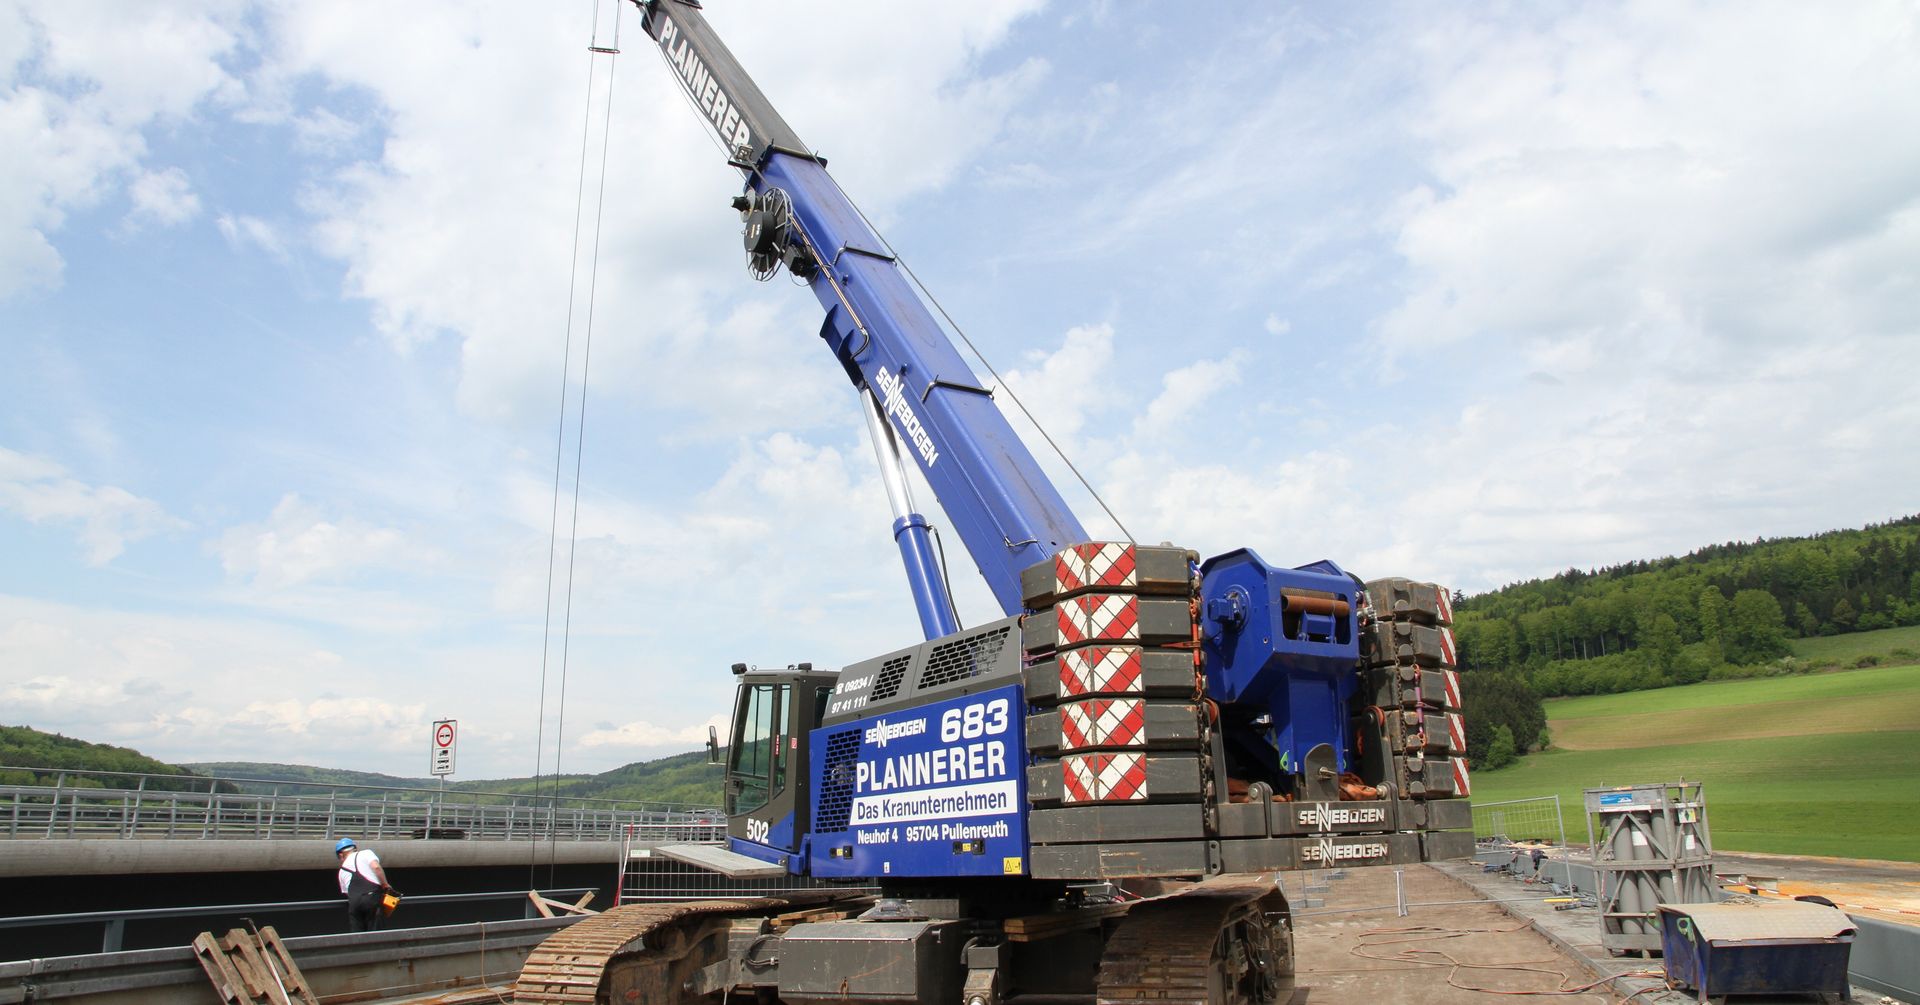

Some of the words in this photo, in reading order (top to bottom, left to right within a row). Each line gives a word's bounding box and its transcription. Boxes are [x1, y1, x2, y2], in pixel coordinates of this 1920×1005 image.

[875, 366, 940, 468] SENNEBOGEN
[844, 676, 868, 693] 09234
[831, 701, 842, 714] 97
[842, 699, 852, 711] 41
[853, 695, 868, 709] 111
[865, 718, 927, 749] SENNEBOGEN
[940, 698, 1009, 743] 683
[856, 740, 1006, 793] PLANNERER
[857, 801, 879, 820] Das
[882, 790, 1007, 818] Kranunternehmen
[1299, 802, 1386, 832] SENNEBOGEN
[746, 818, 769, 844] 502
[857, 828, 890, 845] Neuhof
[891, 827, 899, 843] 4
[906, 824, 939, 842] 95704
[941, 820, 1009, 840] Pullenreuth
[1302, 838, 1388, 868] SENNEBOGEN
